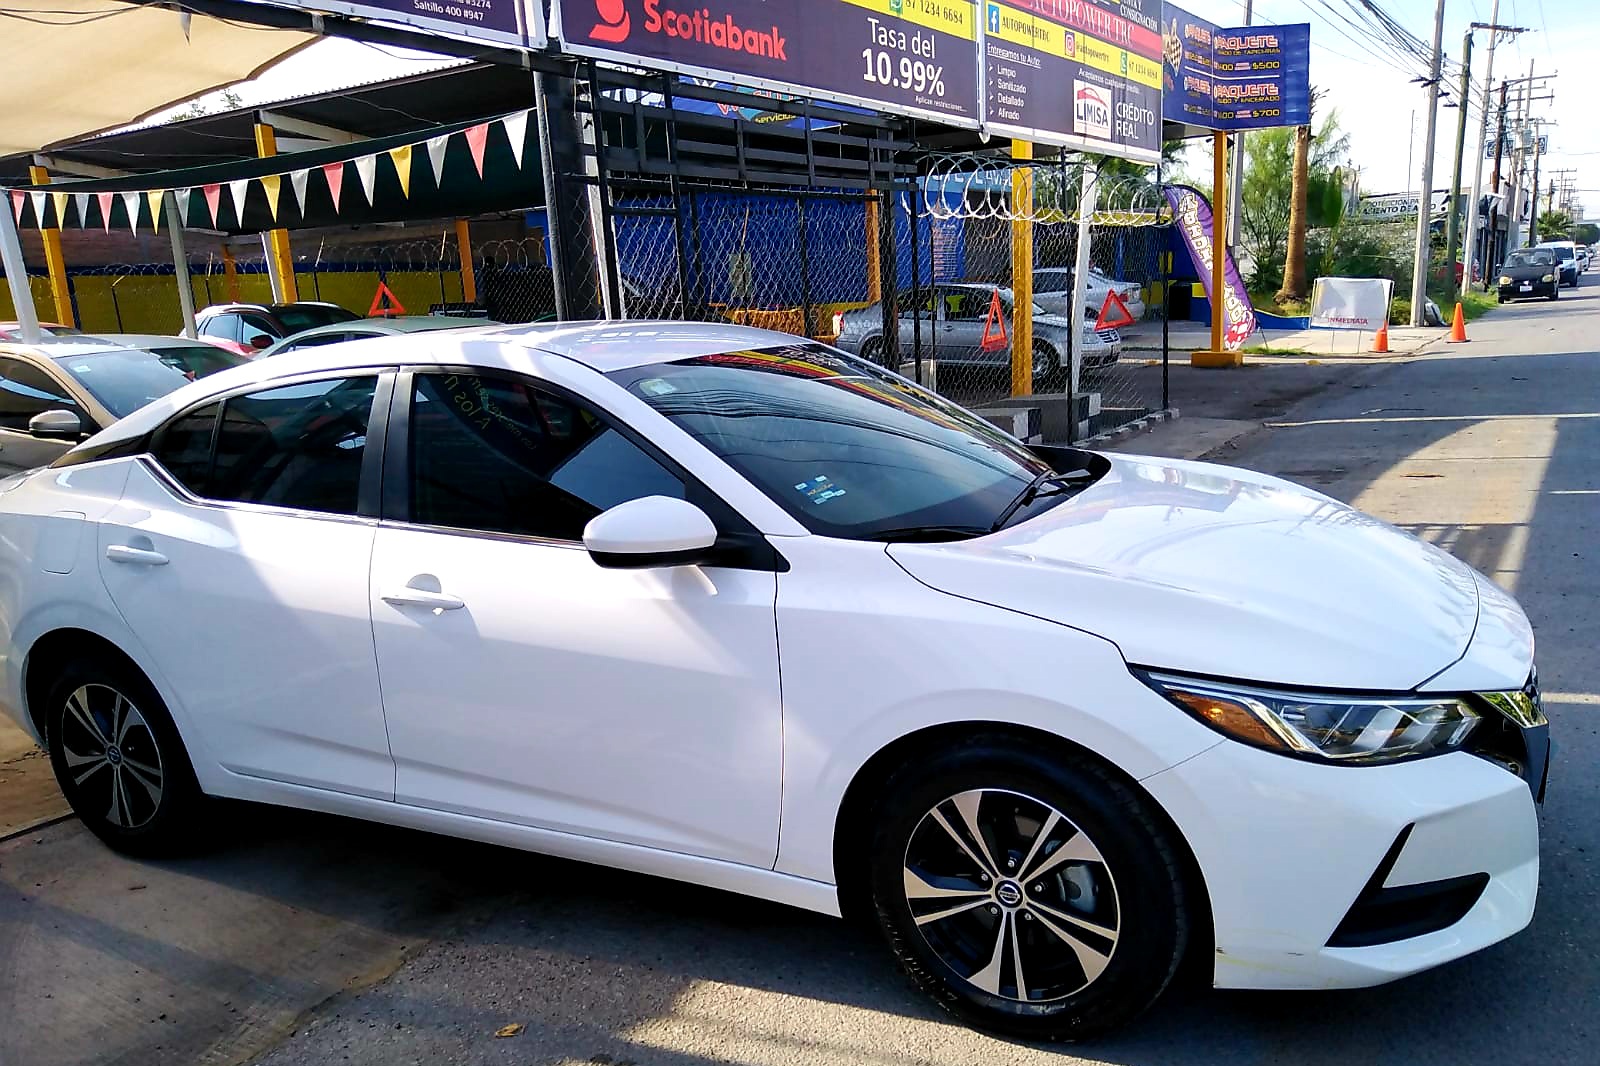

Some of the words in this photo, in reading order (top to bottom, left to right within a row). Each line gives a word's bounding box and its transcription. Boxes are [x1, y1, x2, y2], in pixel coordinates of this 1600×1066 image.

[414, 0, 444, 13] Saltillo
[445, 5, 462, 17] 400
[463, 9, 484, 21] #947
[920, 1, 941, 18] 1234
[943, 6, 963, 25] 6684
[643, 0, 787, 61] Scotiabank
[867, 17, 907, 52] Tasa
[911, 30, 936, 59] del
[862, 48, 945, 97] 10.99%
[1252, 60, 1280, 70] $500
[1116, 102, 1154, 126] CRÉDITO
[1252, 108, 1280, 118] $700
[1116, 119, 1139, 139] REAL
